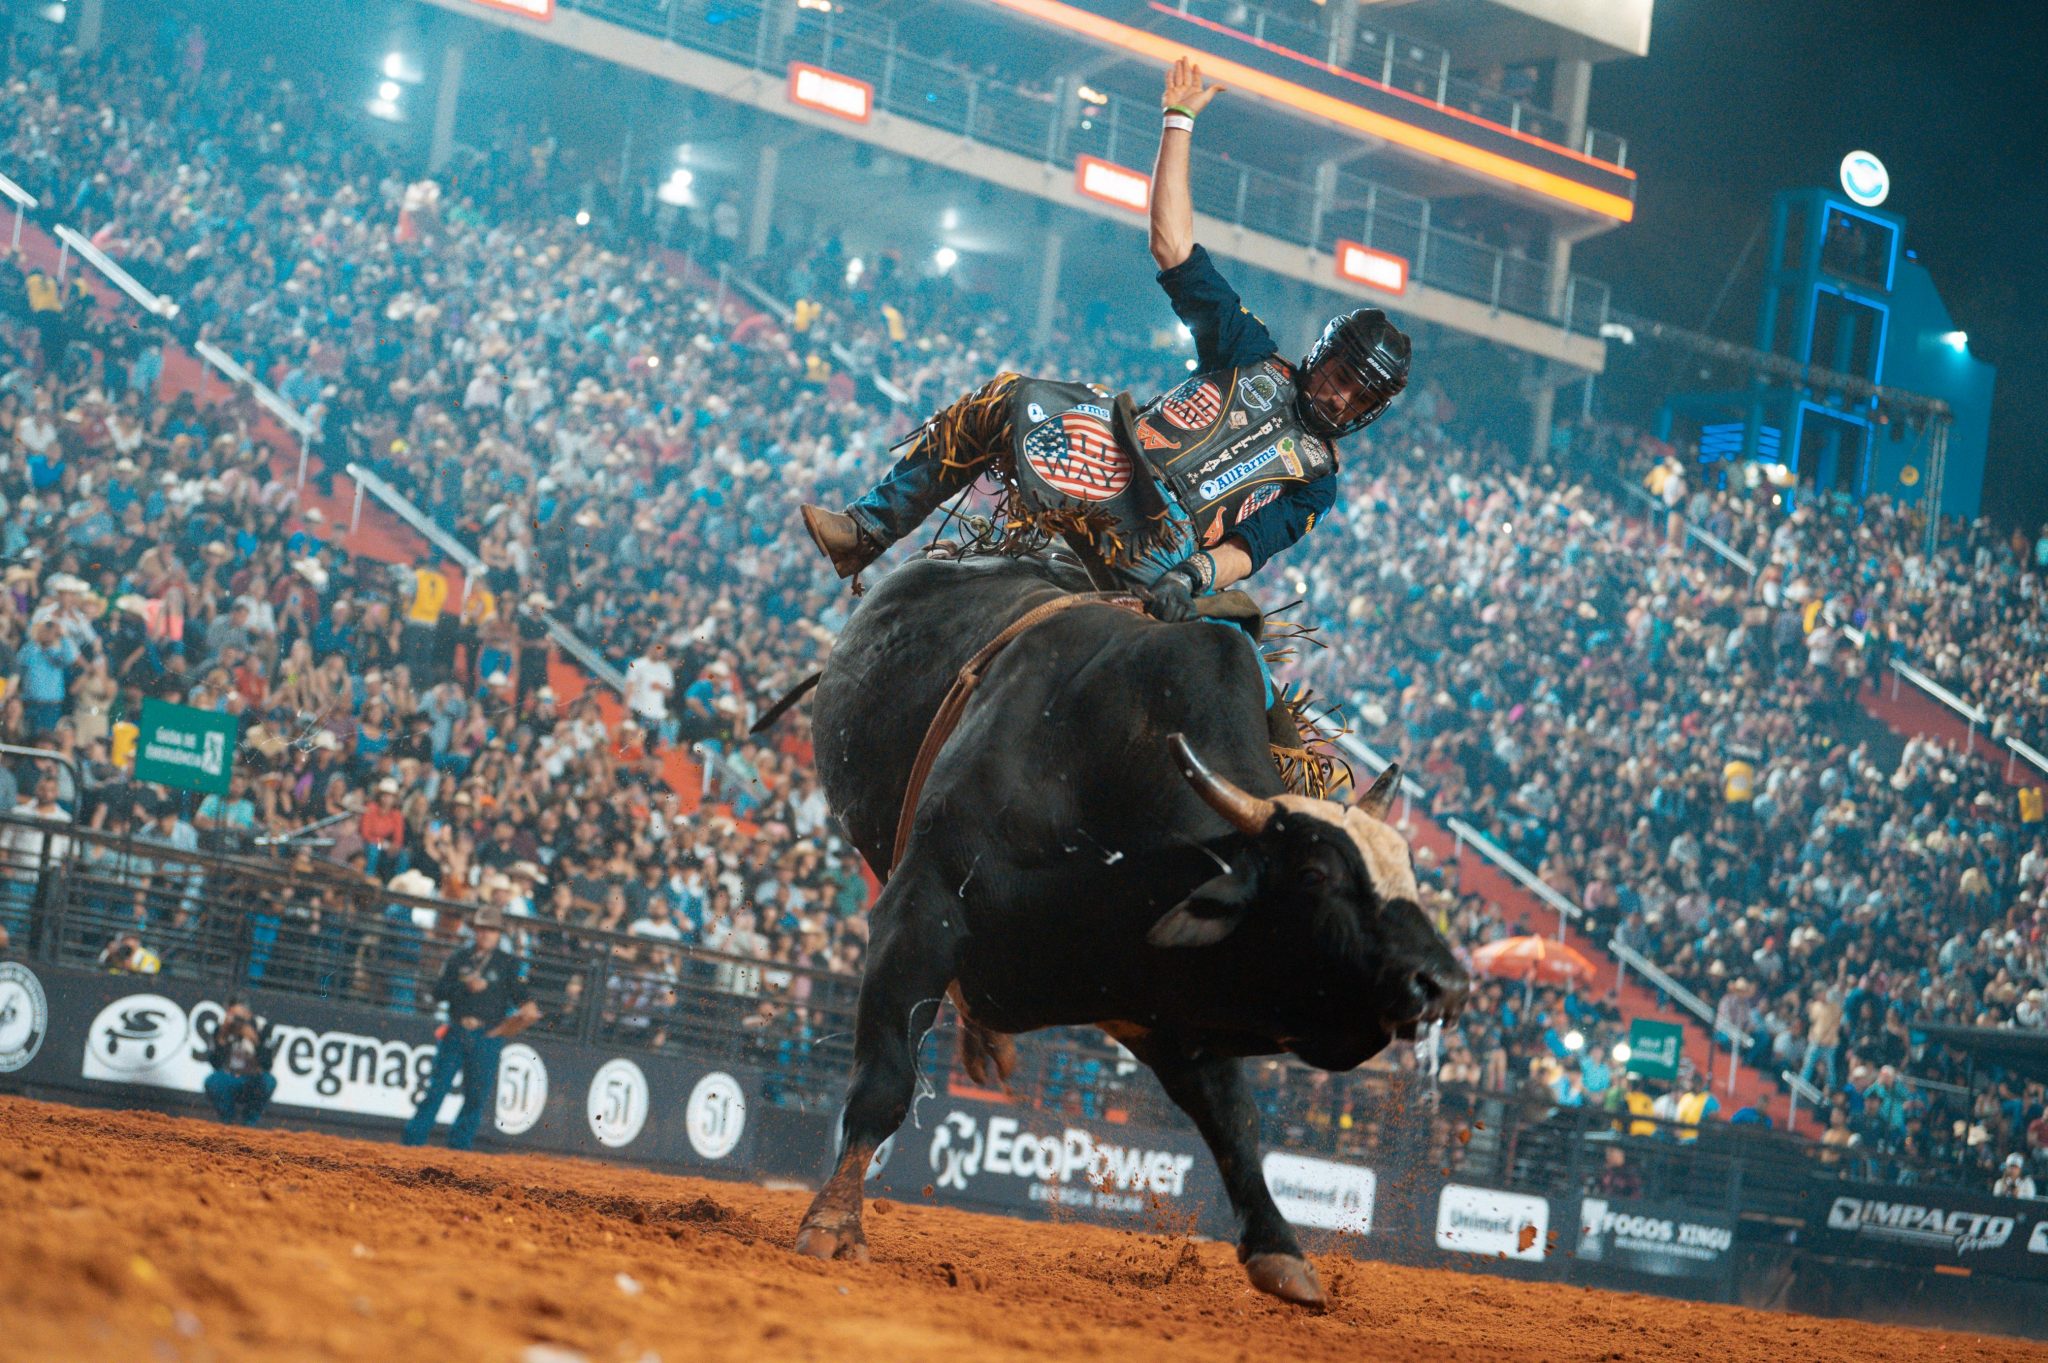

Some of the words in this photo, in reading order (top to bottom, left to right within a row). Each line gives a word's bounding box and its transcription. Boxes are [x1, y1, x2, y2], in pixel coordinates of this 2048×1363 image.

[1366, 357, 1392, 380] BAUER
[1231, 421, 1273, 455] BILL
[1042, 455, 1118, 488] WAY
[1199, 449, 1233, 474] WAY
[1216, 446, 1277, 490] AllFarms
[501, 1066, 529, 1112] 51
[604, 1080, 631, 1126] 51
[1858, 1200, 2016, 1248] IMPACTO
